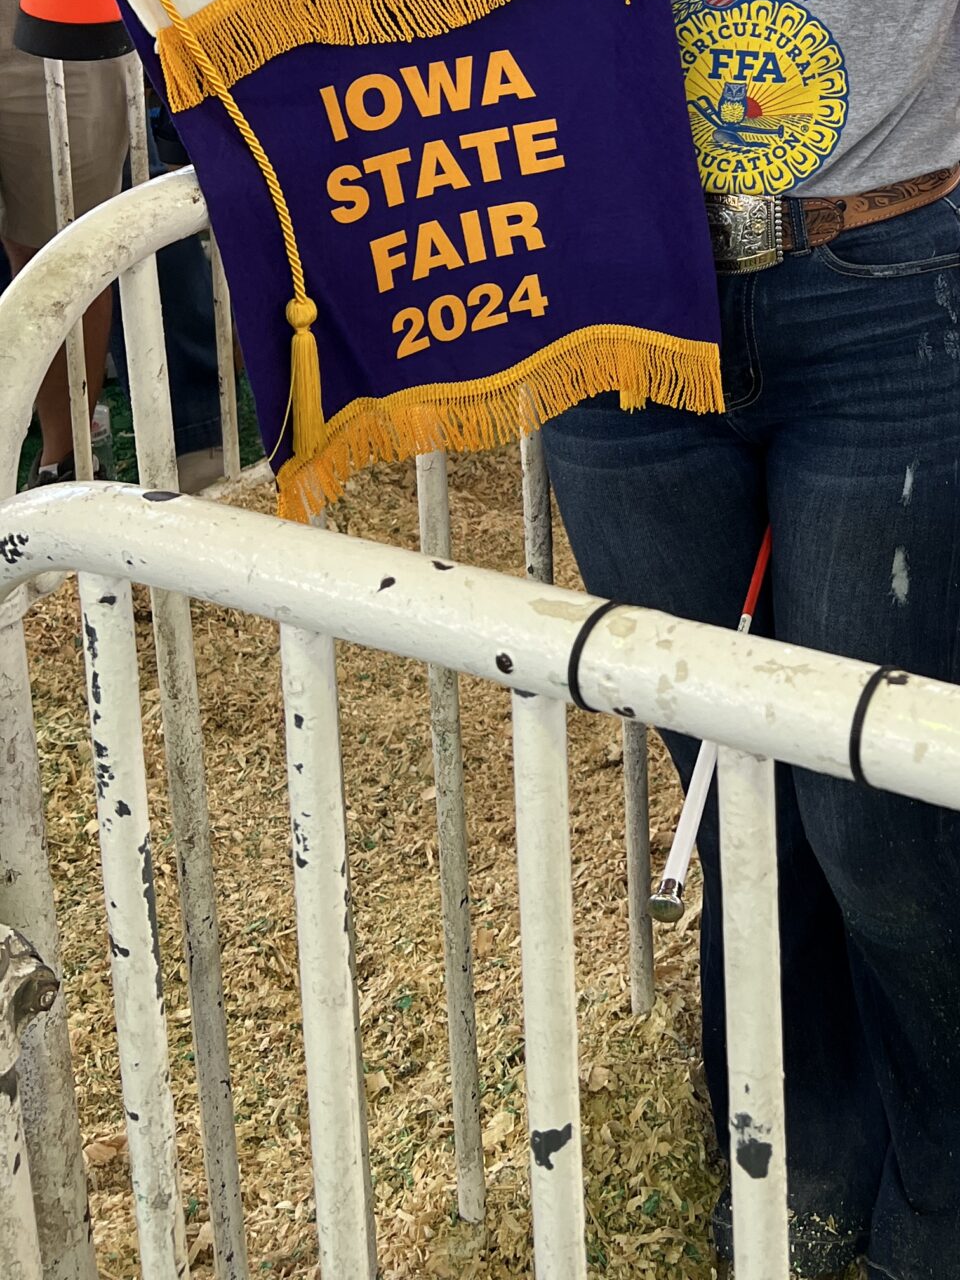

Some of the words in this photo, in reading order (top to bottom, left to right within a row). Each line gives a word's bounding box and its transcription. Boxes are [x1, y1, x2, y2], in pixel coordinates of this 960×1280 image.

[319, 49, 537, 142] IOWA
[683, 21, 817, 88] GRICULTURAL
[708, 48, 787, 83] FFA
[326, 118, 566, 224] STATE
[696, 130, 803, 173] UCATION
[369, 201, 546, 294] FAIR
[391, 273, 550, 360] 2024
